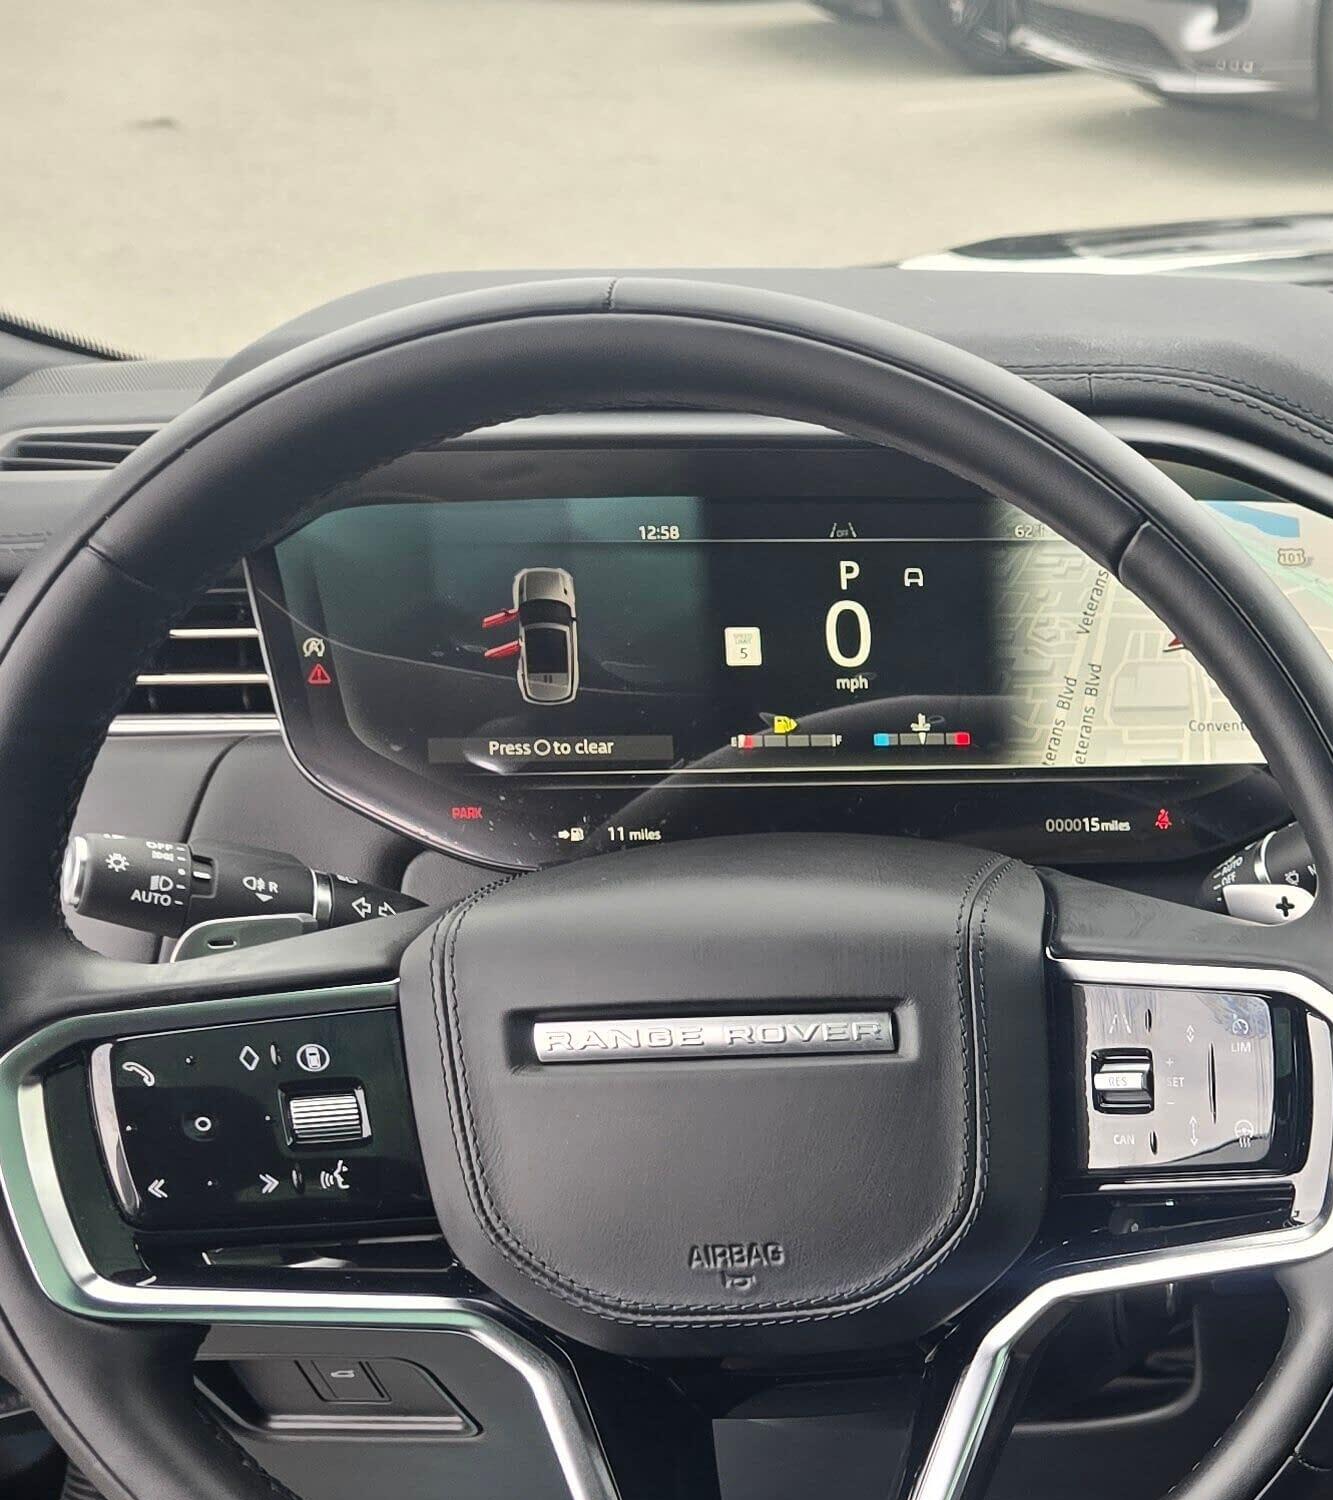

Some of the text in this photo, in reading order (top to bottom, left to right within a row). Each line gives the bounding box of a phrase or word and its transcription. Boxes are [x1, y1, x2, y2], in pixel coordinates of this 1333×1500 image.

[638, 525, 681, 541] 12:58
[839, 560, 860, 590] P
[1077, 569, 1110, 636] Veterans
[825, 600, 872, 668] 0
[739, 647, 748, 660] 5
[836, 675, 869, 692] mph
[1084, 663, 1103, 697] Blvd
[1056, 675, 1079, 712] Blvd
[488, 739, 614, 757] Press to clear
[451, 807, 484, 820] PARK
[1045, 816, 1131, 833] 000015 miles
[607, 826, 662, 842] 11 miles
[268, 880, 279, 894] R
[130, 888, 172, 907] AUTO
[545, 1020, 883, 1052] RANGE ROVER
[1230, 1042, 1252, 1053] LIM
[1108, 1076, 1129, 1087] RES
[1166, 1077, 1185, 1088] SET
[1112, 1134, 1136, 1146] CAN
[687, 1242, 786, 1269] AIRBAG
